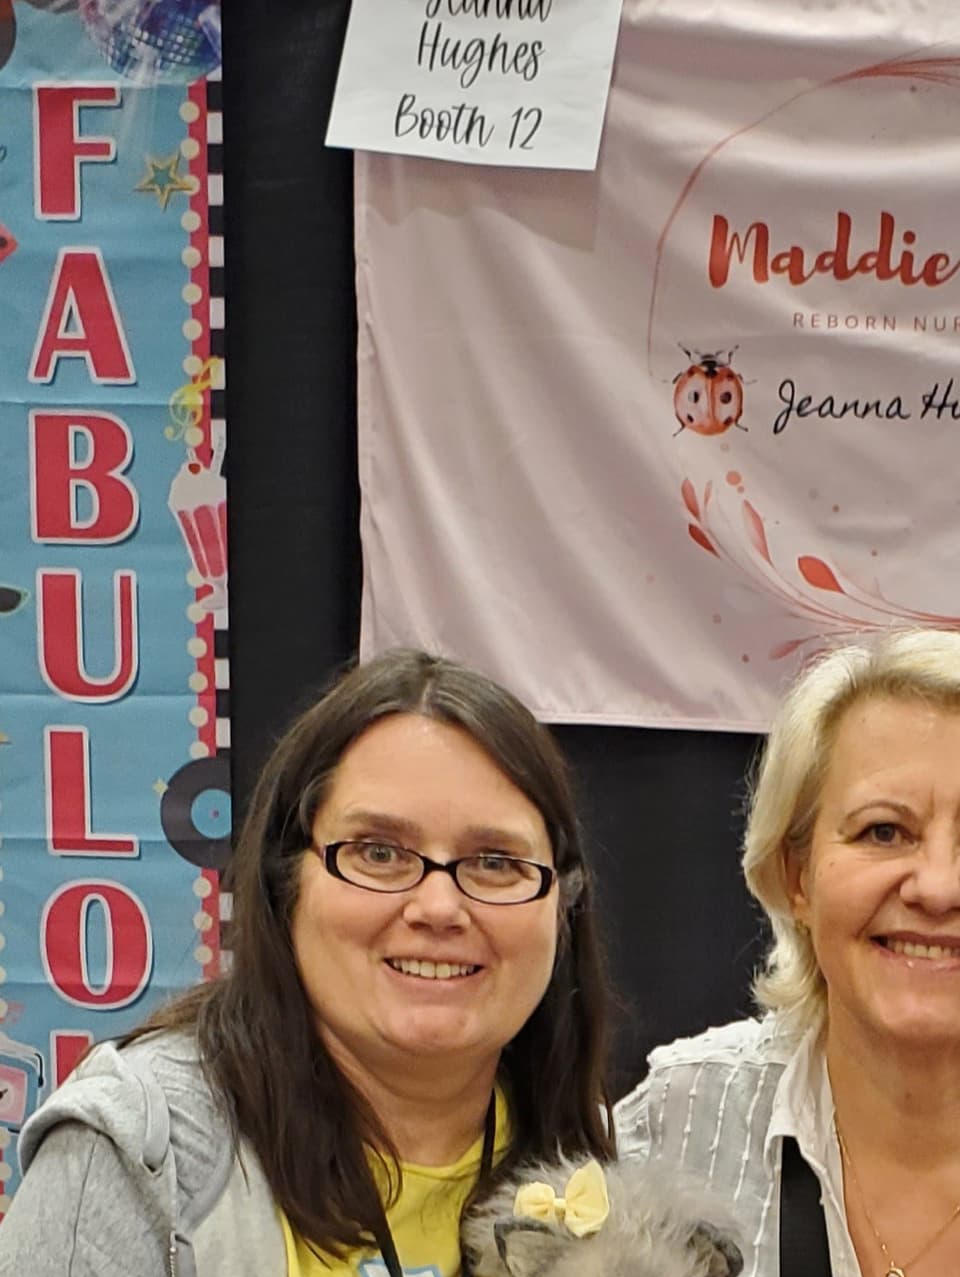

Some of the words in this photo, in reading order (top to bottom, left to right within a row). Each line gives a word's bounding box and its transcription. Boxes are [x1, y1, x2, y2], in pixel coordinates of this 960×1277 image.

[417, 20, 545, 88] Hughes
[394, 93, 495, 148] Booth
[508, 106, 543, 149] 12
[793, 312, 897, 332] REBORN
[773, 379, 911, 435] Jeanna
[27, 80, 154, 1093] FABULO
